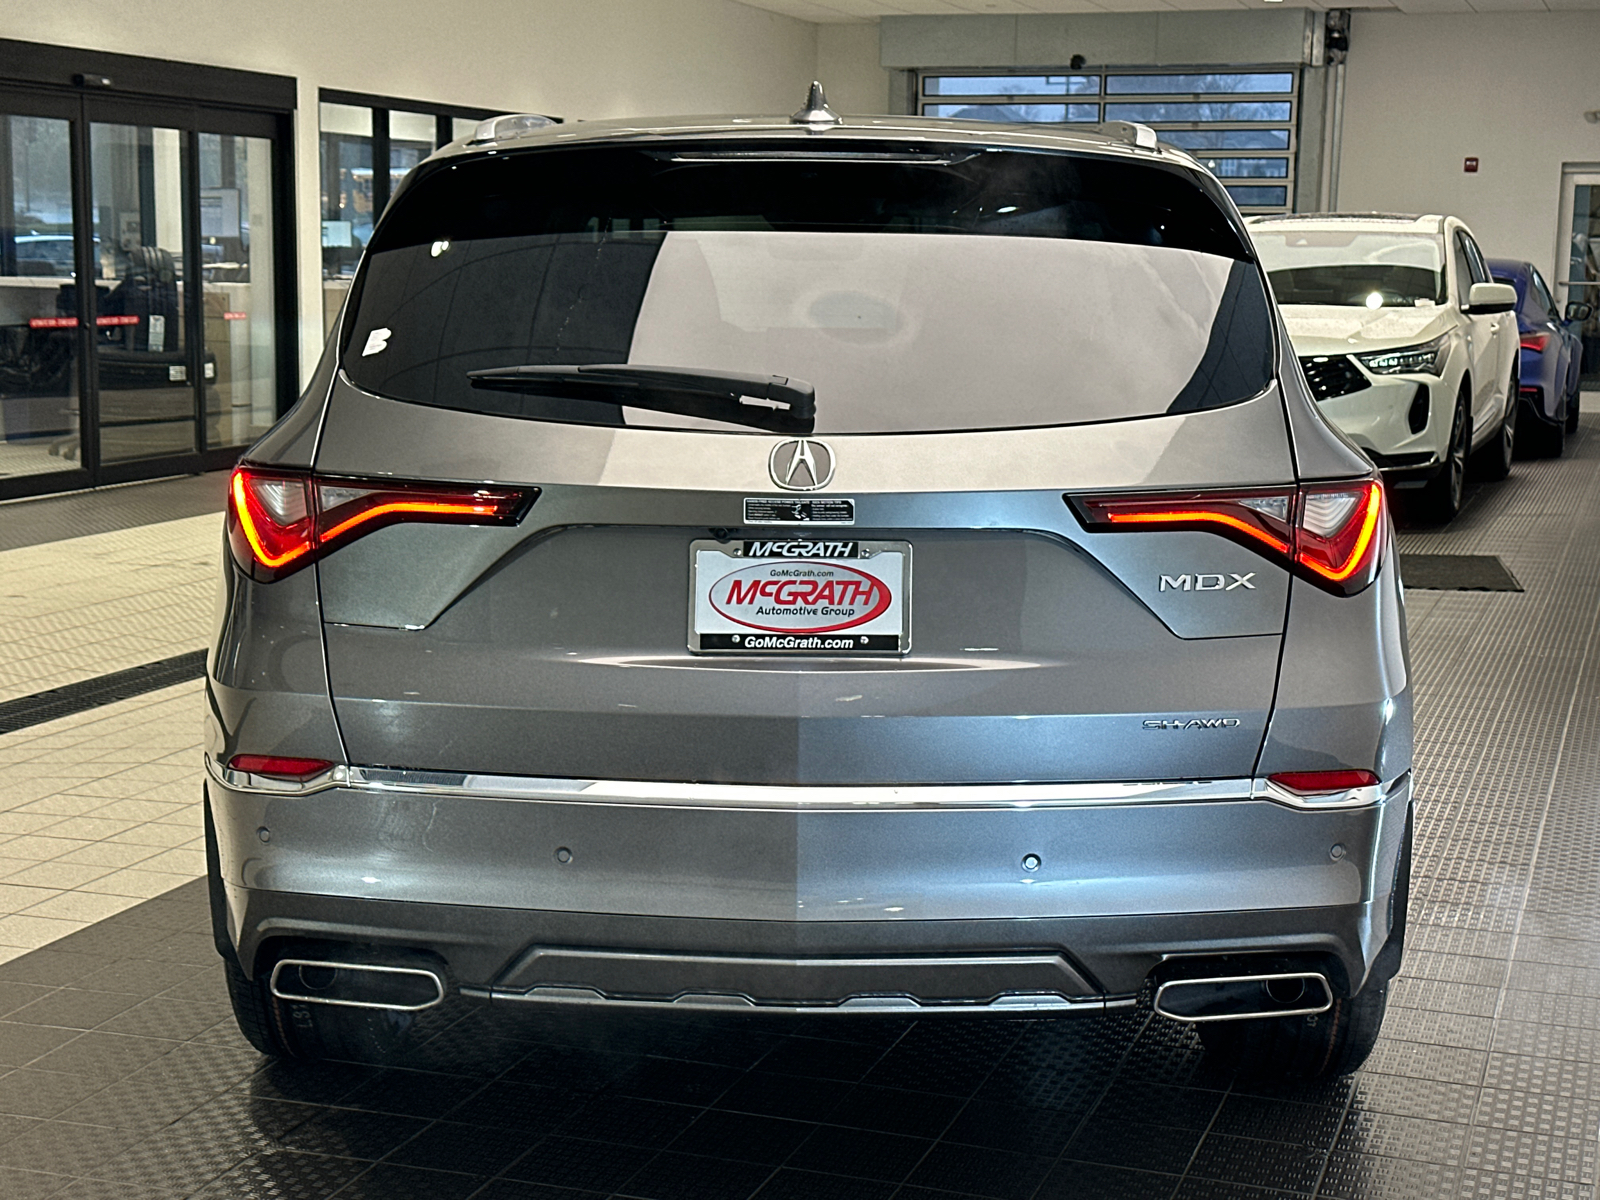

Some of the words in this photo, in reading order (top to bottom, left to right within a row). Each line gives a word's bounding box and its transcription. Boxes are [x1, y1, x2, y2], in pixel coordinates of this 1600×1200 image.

[769, 569, 834, 578] GoMcGrath.com
[1159, 572, 1257, 592] MDX
[755, 606, 819, 616] Automotive
[820, 606, 855, 618] Group
[744, 636, 854, 649] GoMcGrath.com
